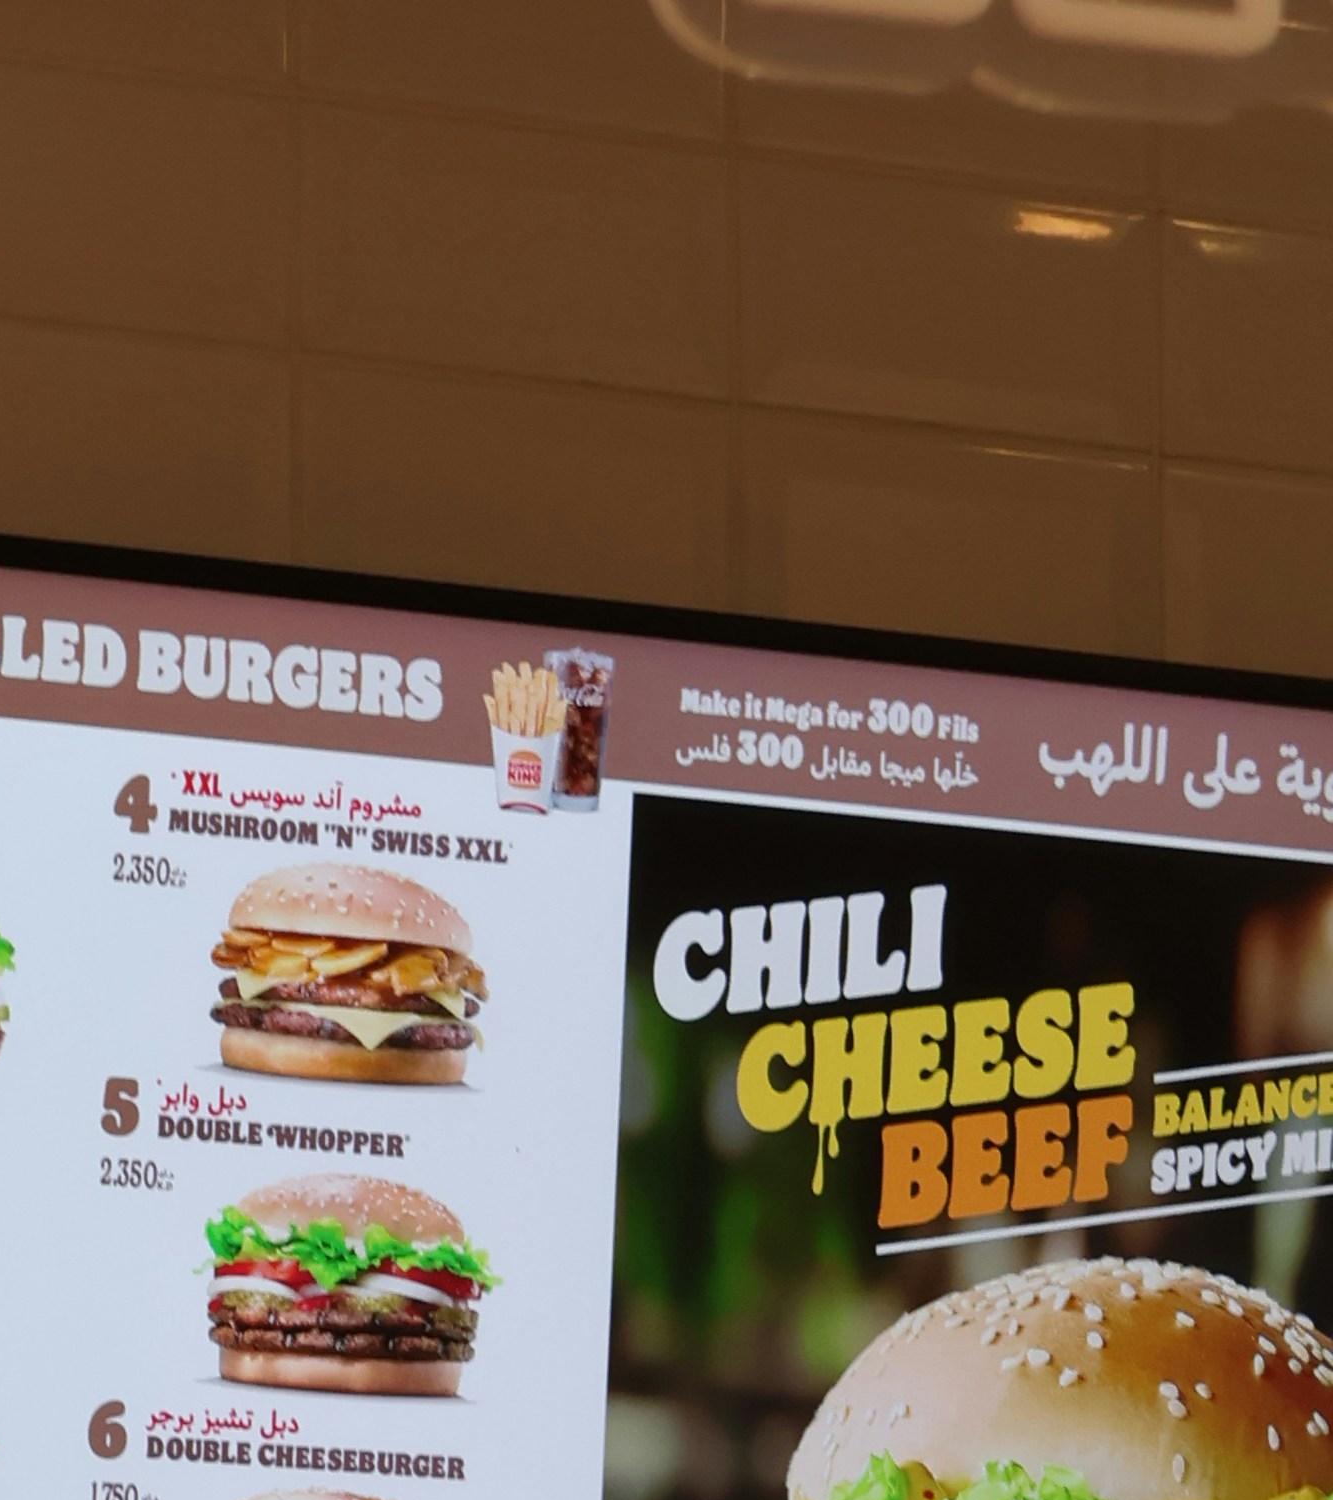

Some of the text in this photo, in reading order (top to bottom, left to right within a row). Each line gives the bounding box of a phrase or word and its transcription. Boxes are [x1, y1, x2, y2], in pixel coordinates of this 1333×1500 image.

[137, 630, 444, 722] BURGERS
[680, 687, 979, 743] Make it Mega for 300 Fils
[675, 733, 732, 767] فلس
[736, 729, 804, 770] 300
[809, 745, 872, 781] مقابل
[879, 751, 926, 788] ميجا
[1038, 722, 1169, 798] اللهب
[1183, 732, 1262, 810] على
[113, 774, 158, 834] 4
[182, 770, 223, 798] XXL
[230, 787, 305, 812] سويس
[349, 794, 422, 822] مشروم
[168, 808, 319, 847] MUSHROOM
[371, 828, 451, 858] SWISS
[455, 836, 509, 864] XXL
[113, 853, 170, 886] 2.350
[653, 884, 947, 1022] CHILI
[736, 982, 1135, 1132] CHEESE
[100, 1076, 140, 1137] 5
[159, 1082, 248, 1118] دبل وابر
[157, 1114, 406, 1159] DOUBLE WHOPPER
[100, 1156, 158, 1189] 2.350
[878, 1095, 1133, 1230] BEEF
[1150, 1130, 1277, 1196] SPICY
[87, 1398, 128, 1460] 6
[145, 1408, 301, 1440] دبل تشيز برجر
[145, 1435, 466, 1481] DOUBLE CHEESEBURGER
